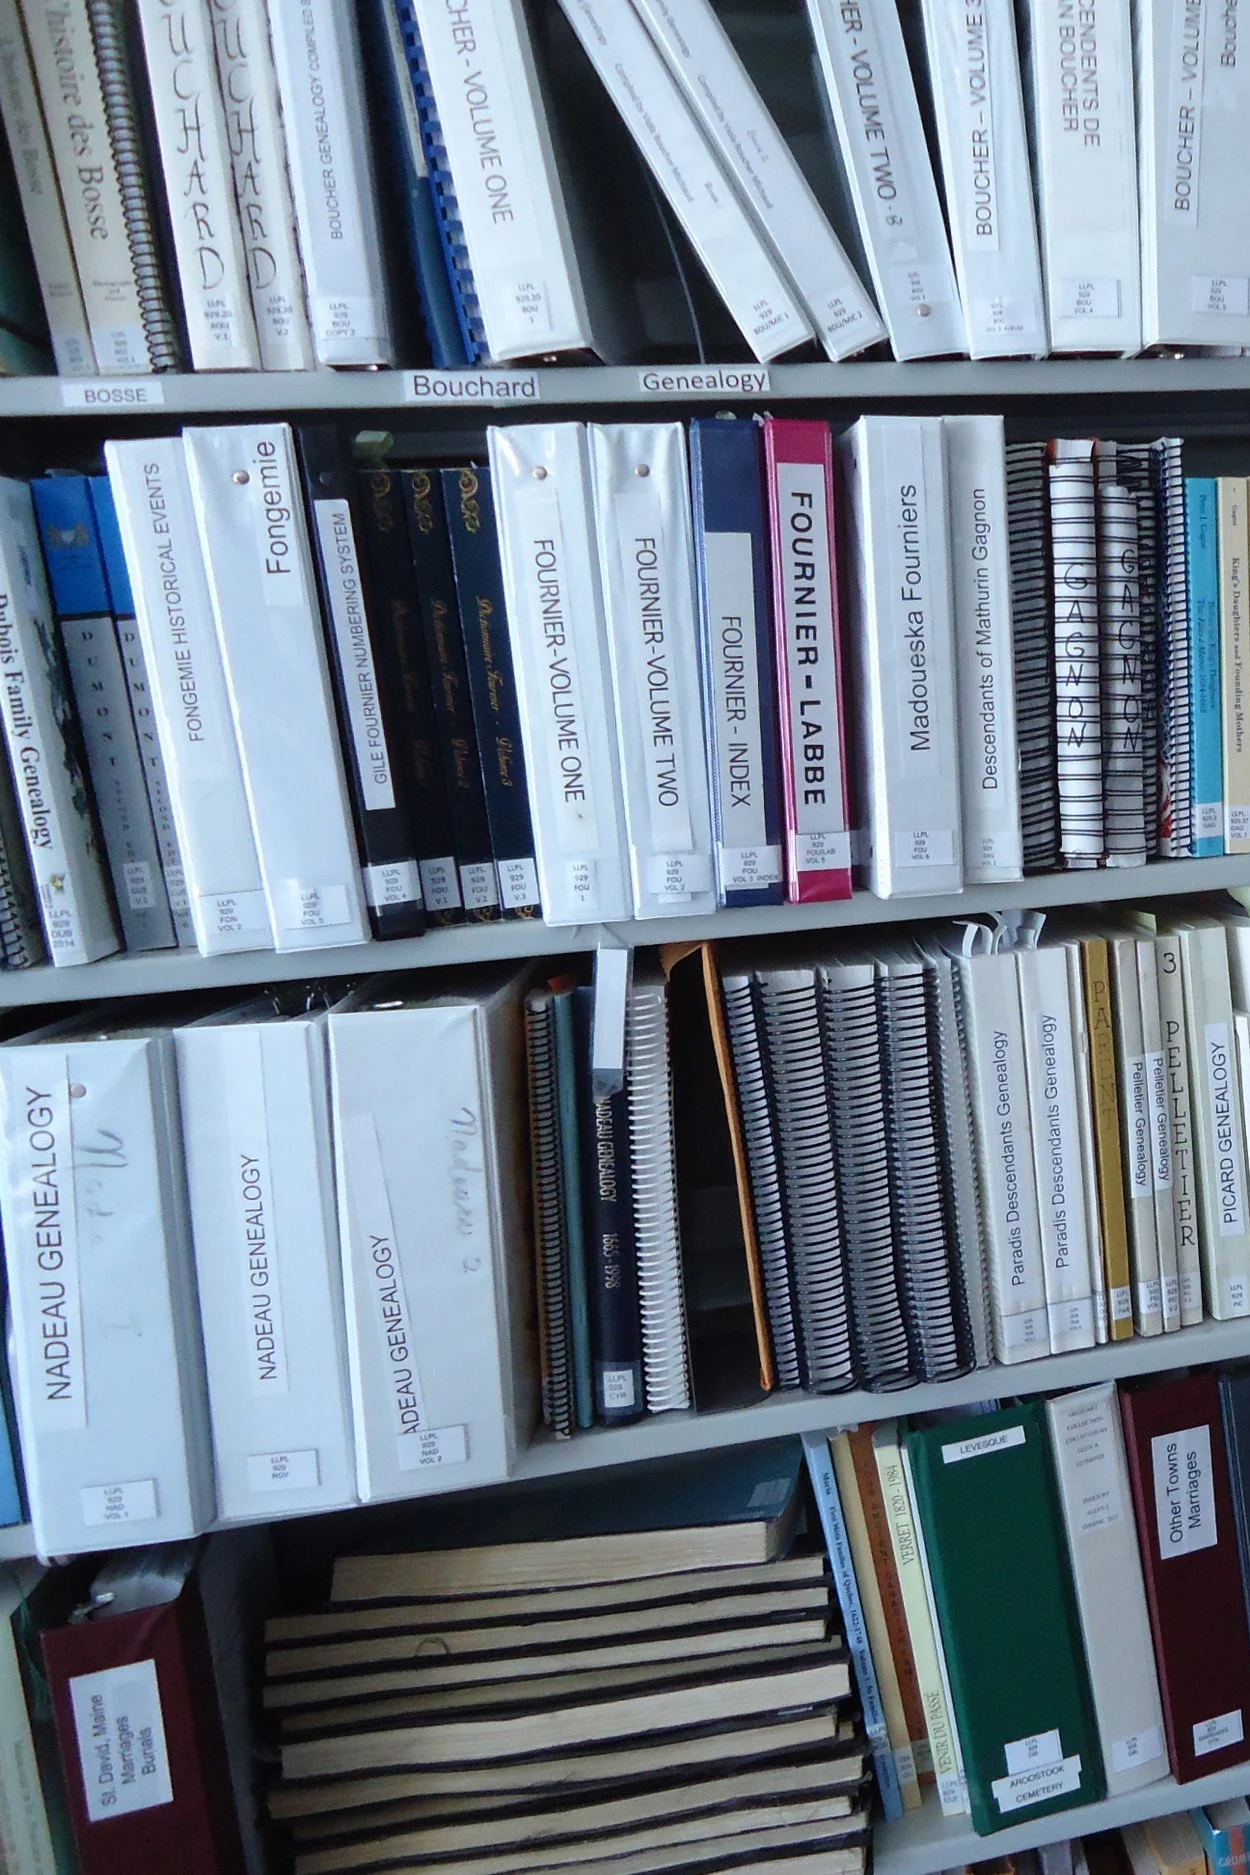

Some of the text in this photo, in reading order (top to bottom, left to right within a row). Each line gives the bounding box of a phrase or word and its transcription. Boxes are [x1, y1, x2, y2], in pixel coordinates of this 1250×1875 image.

[312, 75, 333, 163] GENEALOGY
[464, 70, 514, 223] VOLUME ONE
[851, 49, 898, 199] VOLUME TWO
[965, 19, 992, 236] BOUCHER VOLUME
[1174, 106, 1195, 211] BOUCHER
[325, 168, 344, 240] BOUCHER
[85, 388, 147, 403] BOSSE
[413, 374, 535, 398] Bouchard
[642, 370, 766, 393] Genealogy
[253, 441, 292, 574] Fongemie
[143, 461, 203, 743] FONGEMIE HISTORICAL EVENTS
[897, 484, 931, 751] Madoueska Fourniers
[1231, 557, 1241, 587] King's
[1232, 591, 1242, 642] Daughters
[331, 512, 387, 785] GILE FOURNIER NUMBERING SYSTEM
[533, 538, 585, 803] FOURNIER-VOLUME ONE
[634, 537, 679, 807] FOURNIER-VOLUME TWO
[790, 491, 826, 805] FOURNIER LABBE
[971, 487, 999, 791] Descendants of Mathurin Gagnon
[1064, 562, 1088, 749] GAGNON
[1233, 663, 1243, 709] Founding
[2, 669, 54, 850] Family Genealogy
[721, 615, 751, 808] FOURNIER INDEX
[1235, 712, 1244, 752] Mothers
[1164, 951, 1177, 974] 3
[992, 1030, 1025, 1286] Paradis Descendants Genealogy
[1045, 1015, 1070, 1268] Paradis Descendants Genealogy
[1133, 1062, 1147, 1186] Pelletier Genealogy
[1165, 1021, 1195, 1246] PELLETIER
[1211, 1042, 1238, 1224] PICARD GENEALOGY
[26, 1085, 72, 1400] NADEAU GENEALOGY
[241, 1154, 276, 1380] NADEAU GENEALOGY
[371, 1234, 420, 1434] ADEAU GENEALOGY
[888, 1464, 899, 1488] 1984
[959, 1434, 1008, 1454] LEVESQUE
[1166, 1443, 1183, 1543] Other Towns
[1186, 1451, 1202, 1529] Marriages
[898, 1523, 916, 1565] VERRET
[91, 1695, 116, 1806] St. David, Maine
[115, 1716, 135, 1784] Marriages
[139, 1726, 156, 1776] Burials
[1010, 1766, 1064, 1788] AROOSTOOK
[1016, 1782, 1063, 1803] CEMETERY
